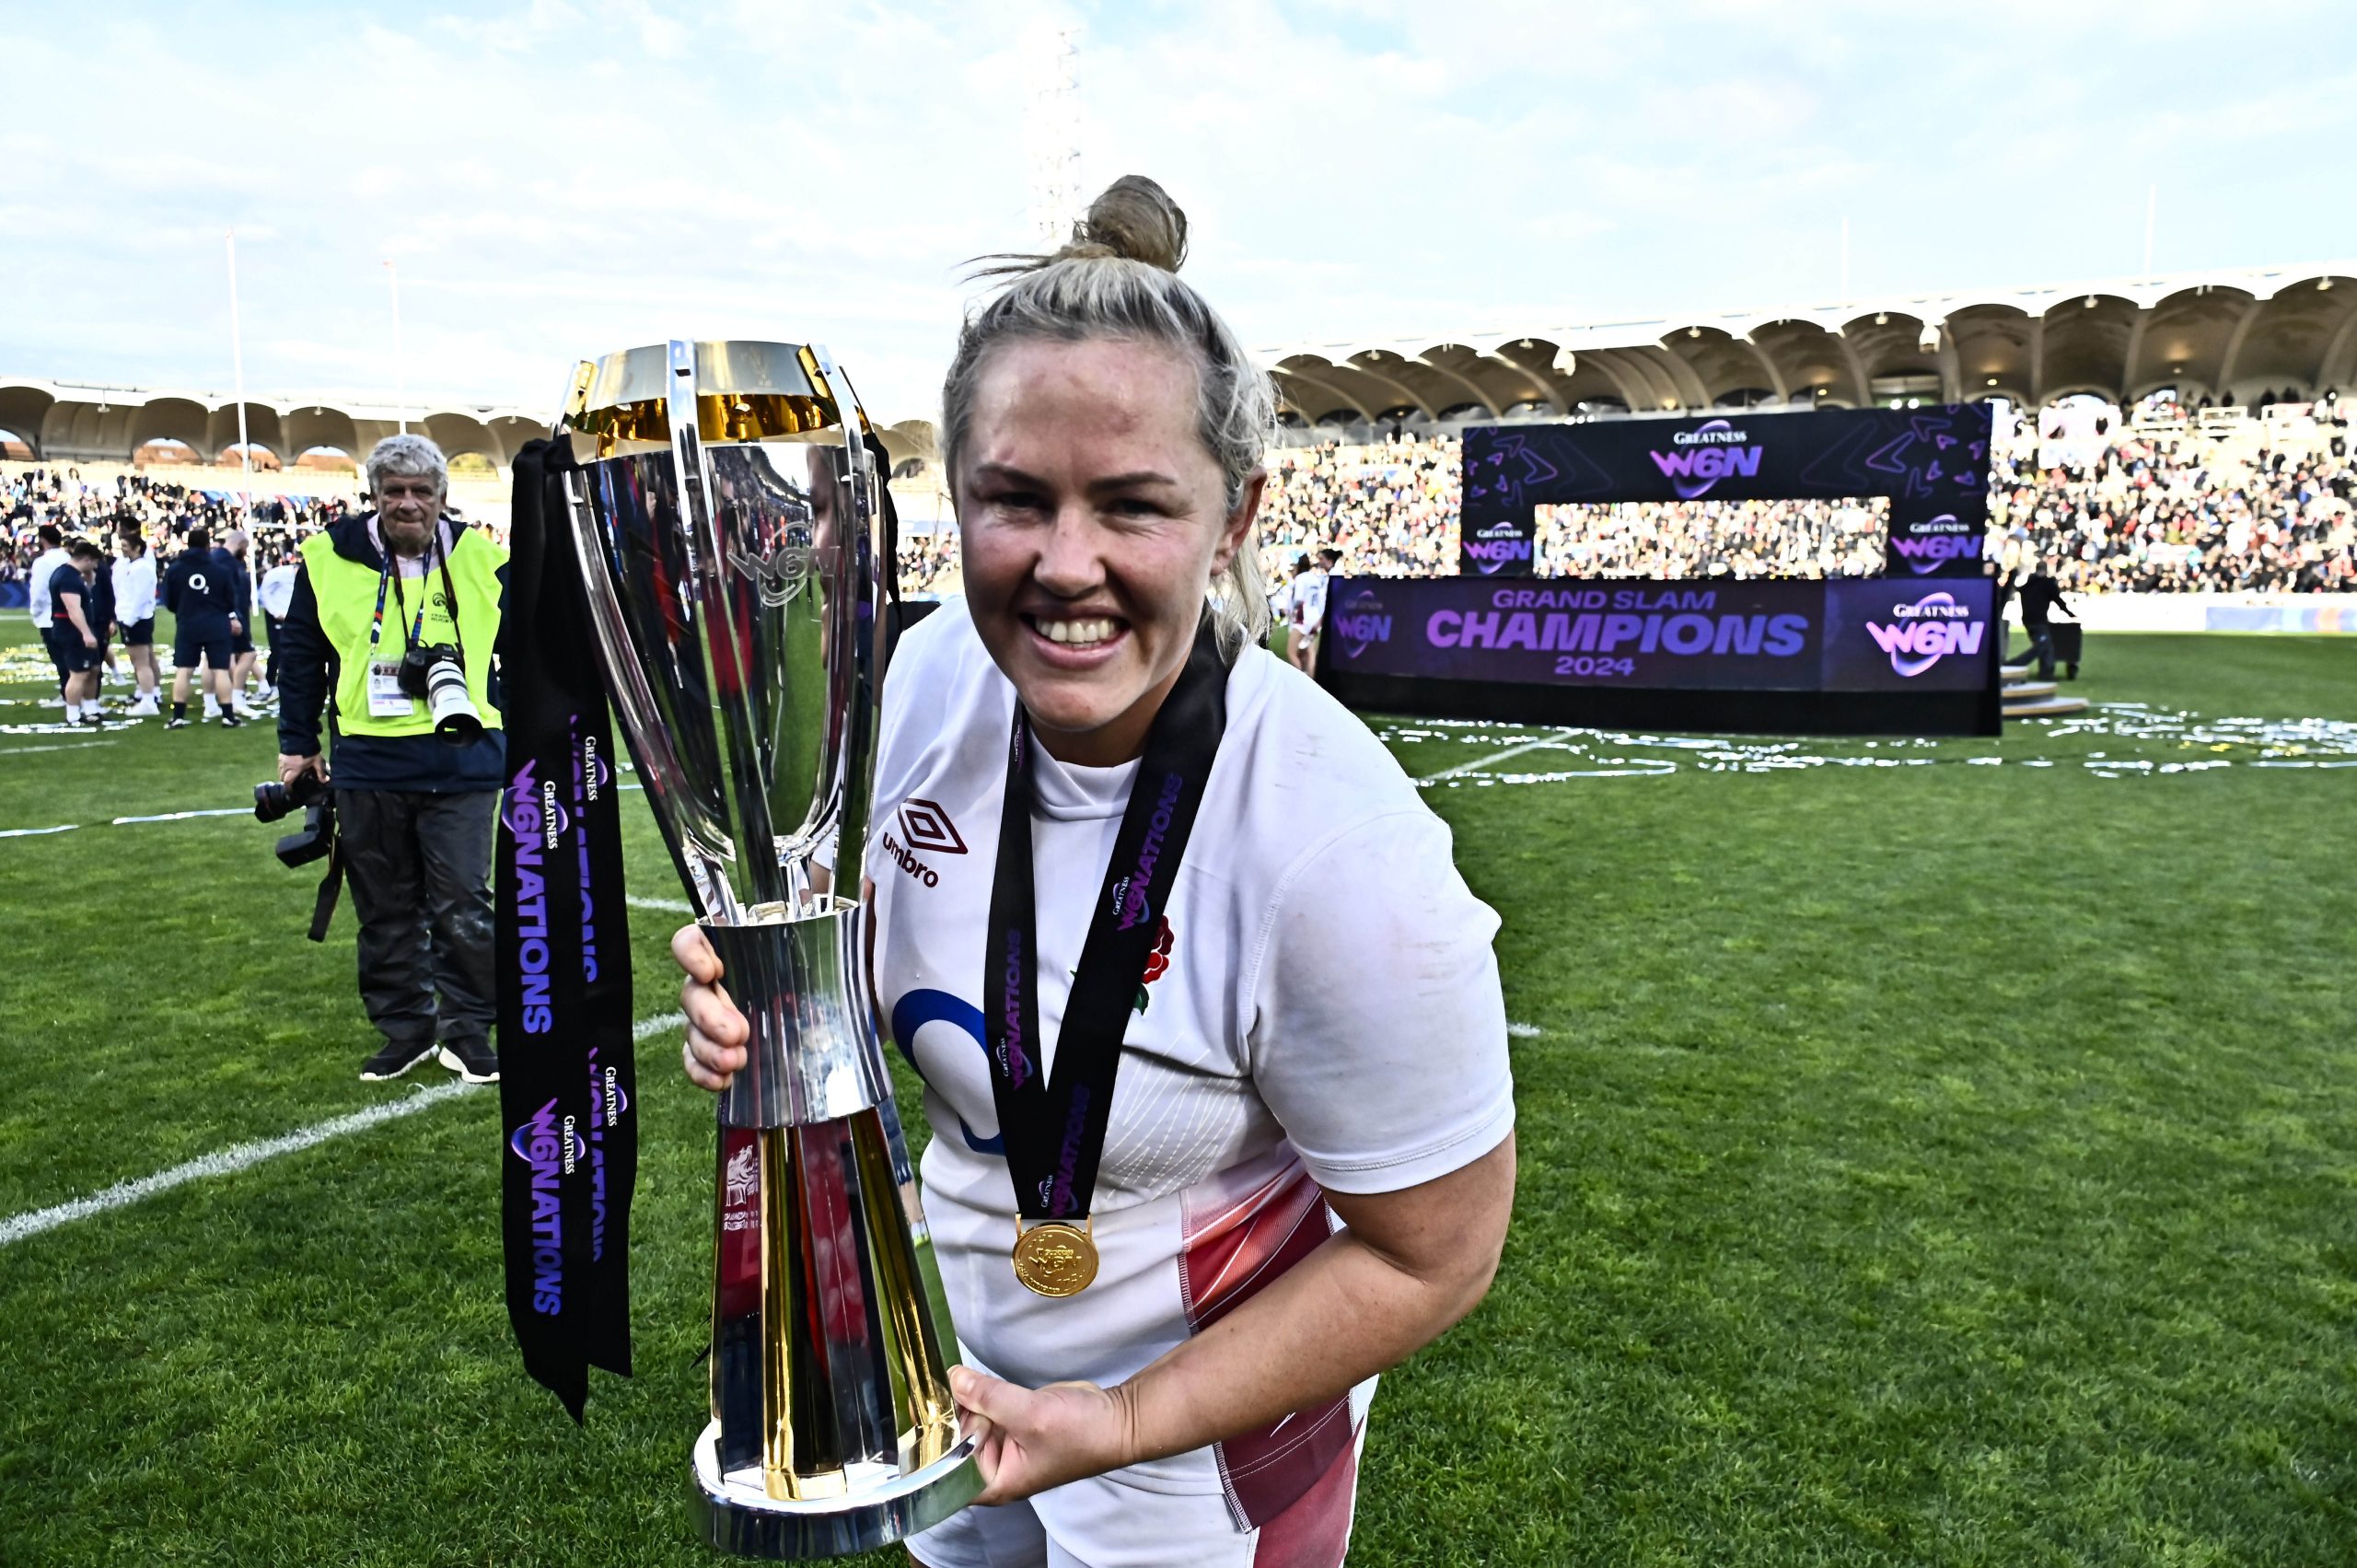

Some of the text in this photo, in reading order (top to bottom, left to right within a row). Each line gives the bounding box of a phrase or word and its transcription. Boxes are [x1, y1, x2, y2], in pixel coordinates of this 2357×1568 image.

[1650, 446, 1762, 478] W6N
[1674, 431, 1747, 445] GREATNESS
[1492, 589, 1717, 610] GRAND SLAM
[1426, 610, 1809, 656] CHAMPIONS
[1865, 621, 1985, 655] W6N
[1554, 656, 1636, 677] 2024
[585, 736, 598, 802] GREATNESS
[543, 780, 558, 850] GREATNESS
[882, 831, 939, 889] umbro
[513, 759, 552, 1035] W6NATIONS
[605, 1066, 618, 1127] GREATNESS
[563, 1115, 575, 1175] GREATNESS
[530, 1098, 563, 1316] W6NATIONS
